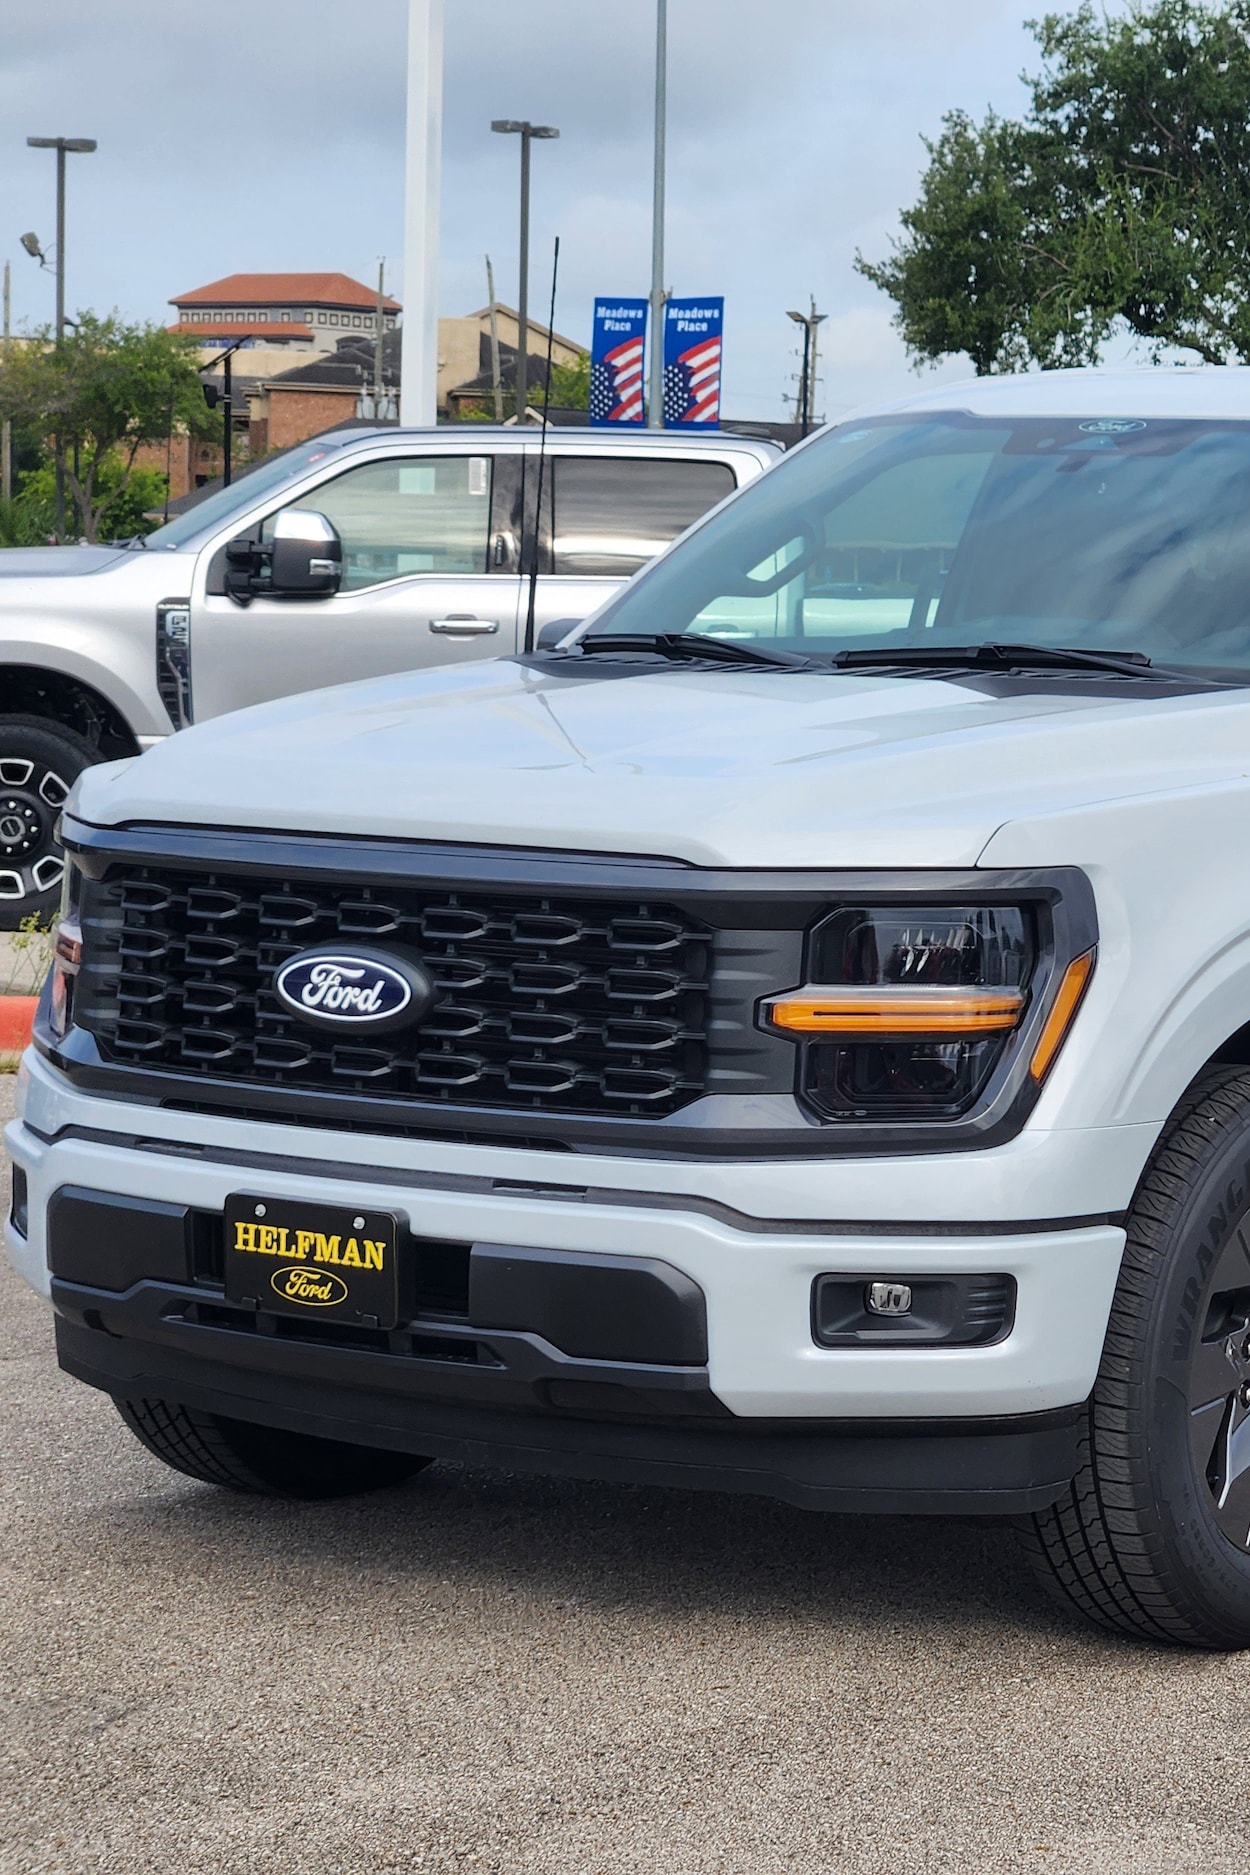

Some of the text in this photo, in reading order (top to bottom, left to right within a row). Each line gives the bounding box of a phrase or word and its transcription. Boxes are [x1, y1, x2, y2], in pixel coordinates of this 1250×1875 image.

[597, 306, 643, 318] Meadows
[668, 307, 720, 319] Meadows
[604, 319, 632, 331] Place
[677, 320, 708, 332] Place
[301, 963, 386, 1013] Ford
[234, 1221, 387, 1271] HELFMAN
[284, 1269, 334, 1301] Ford
